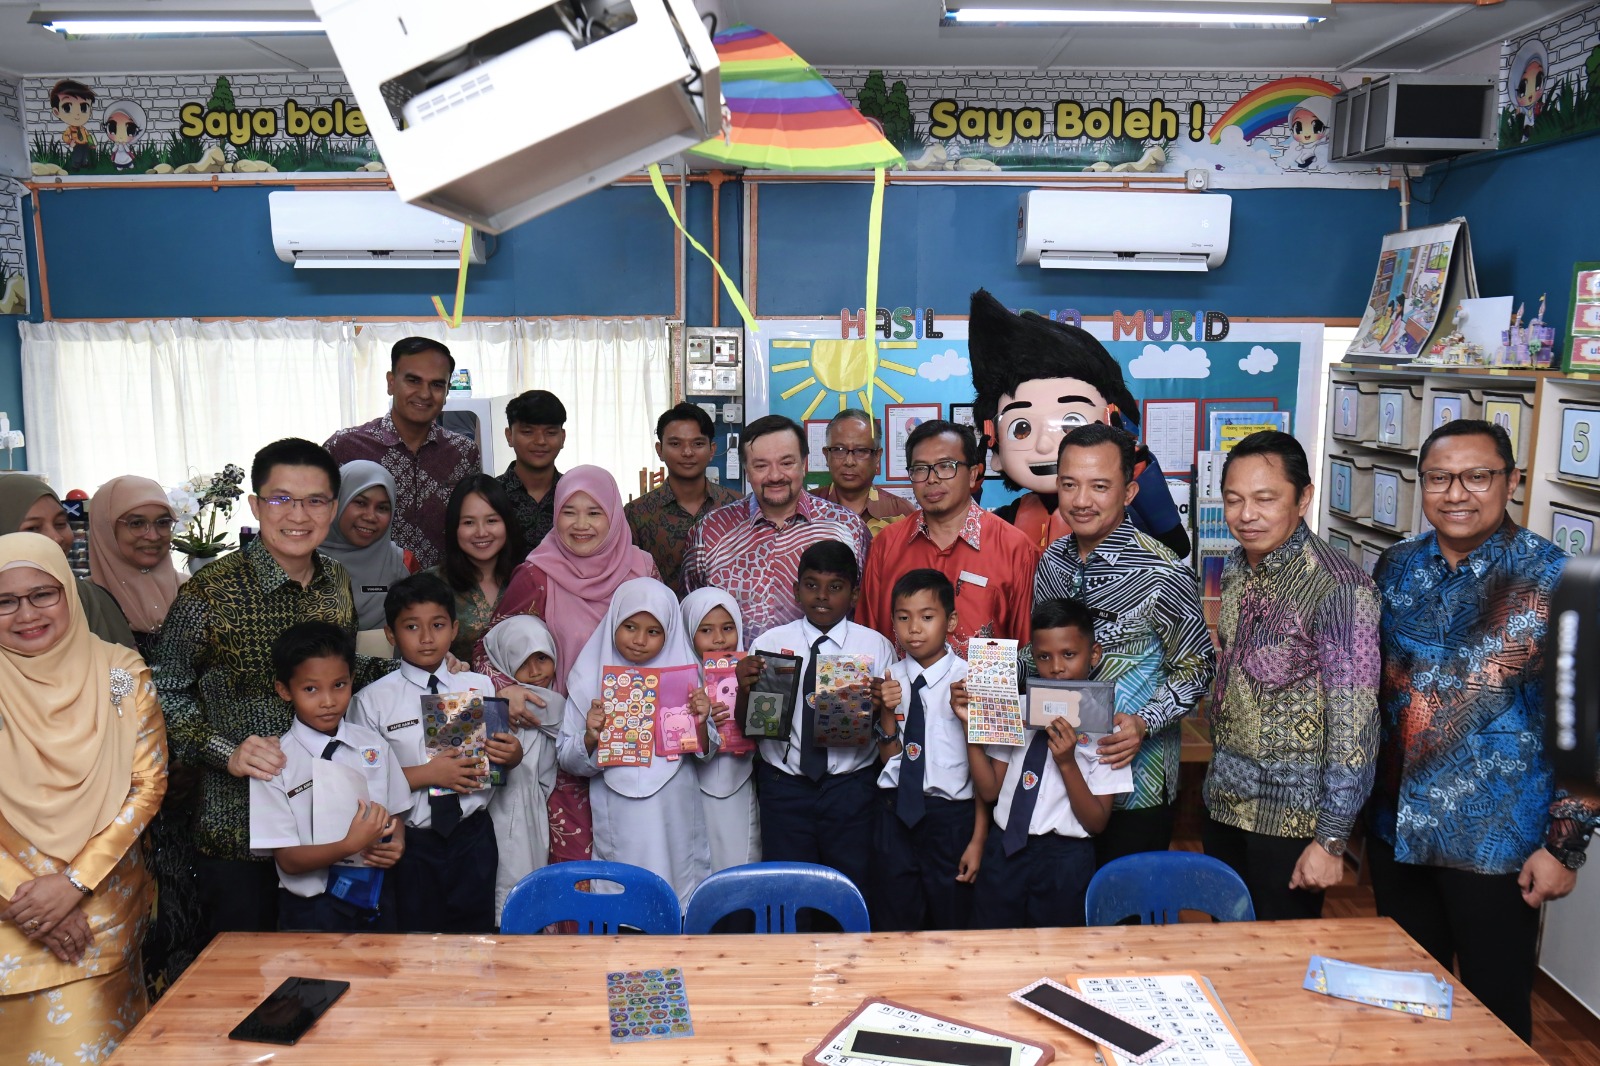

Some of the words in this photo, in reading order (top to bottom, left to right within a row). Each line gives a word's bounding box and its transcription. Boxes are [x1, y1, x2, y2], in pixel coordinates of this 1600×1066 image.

[181, 102, 277, 146] Saya
[284, 98, 369, 137] bole
[929, 100, 1044, 148] Saya
[1054, 97, 1179, 141] Boleh
[841, 307, 943, 339] HASIL
[1112, 309, 1230, 342] MURID
[1384, 402, 1396, 434] 2
[1571, 422, 1590, 462] 5
[1376, 483, 1395, 514] 10
